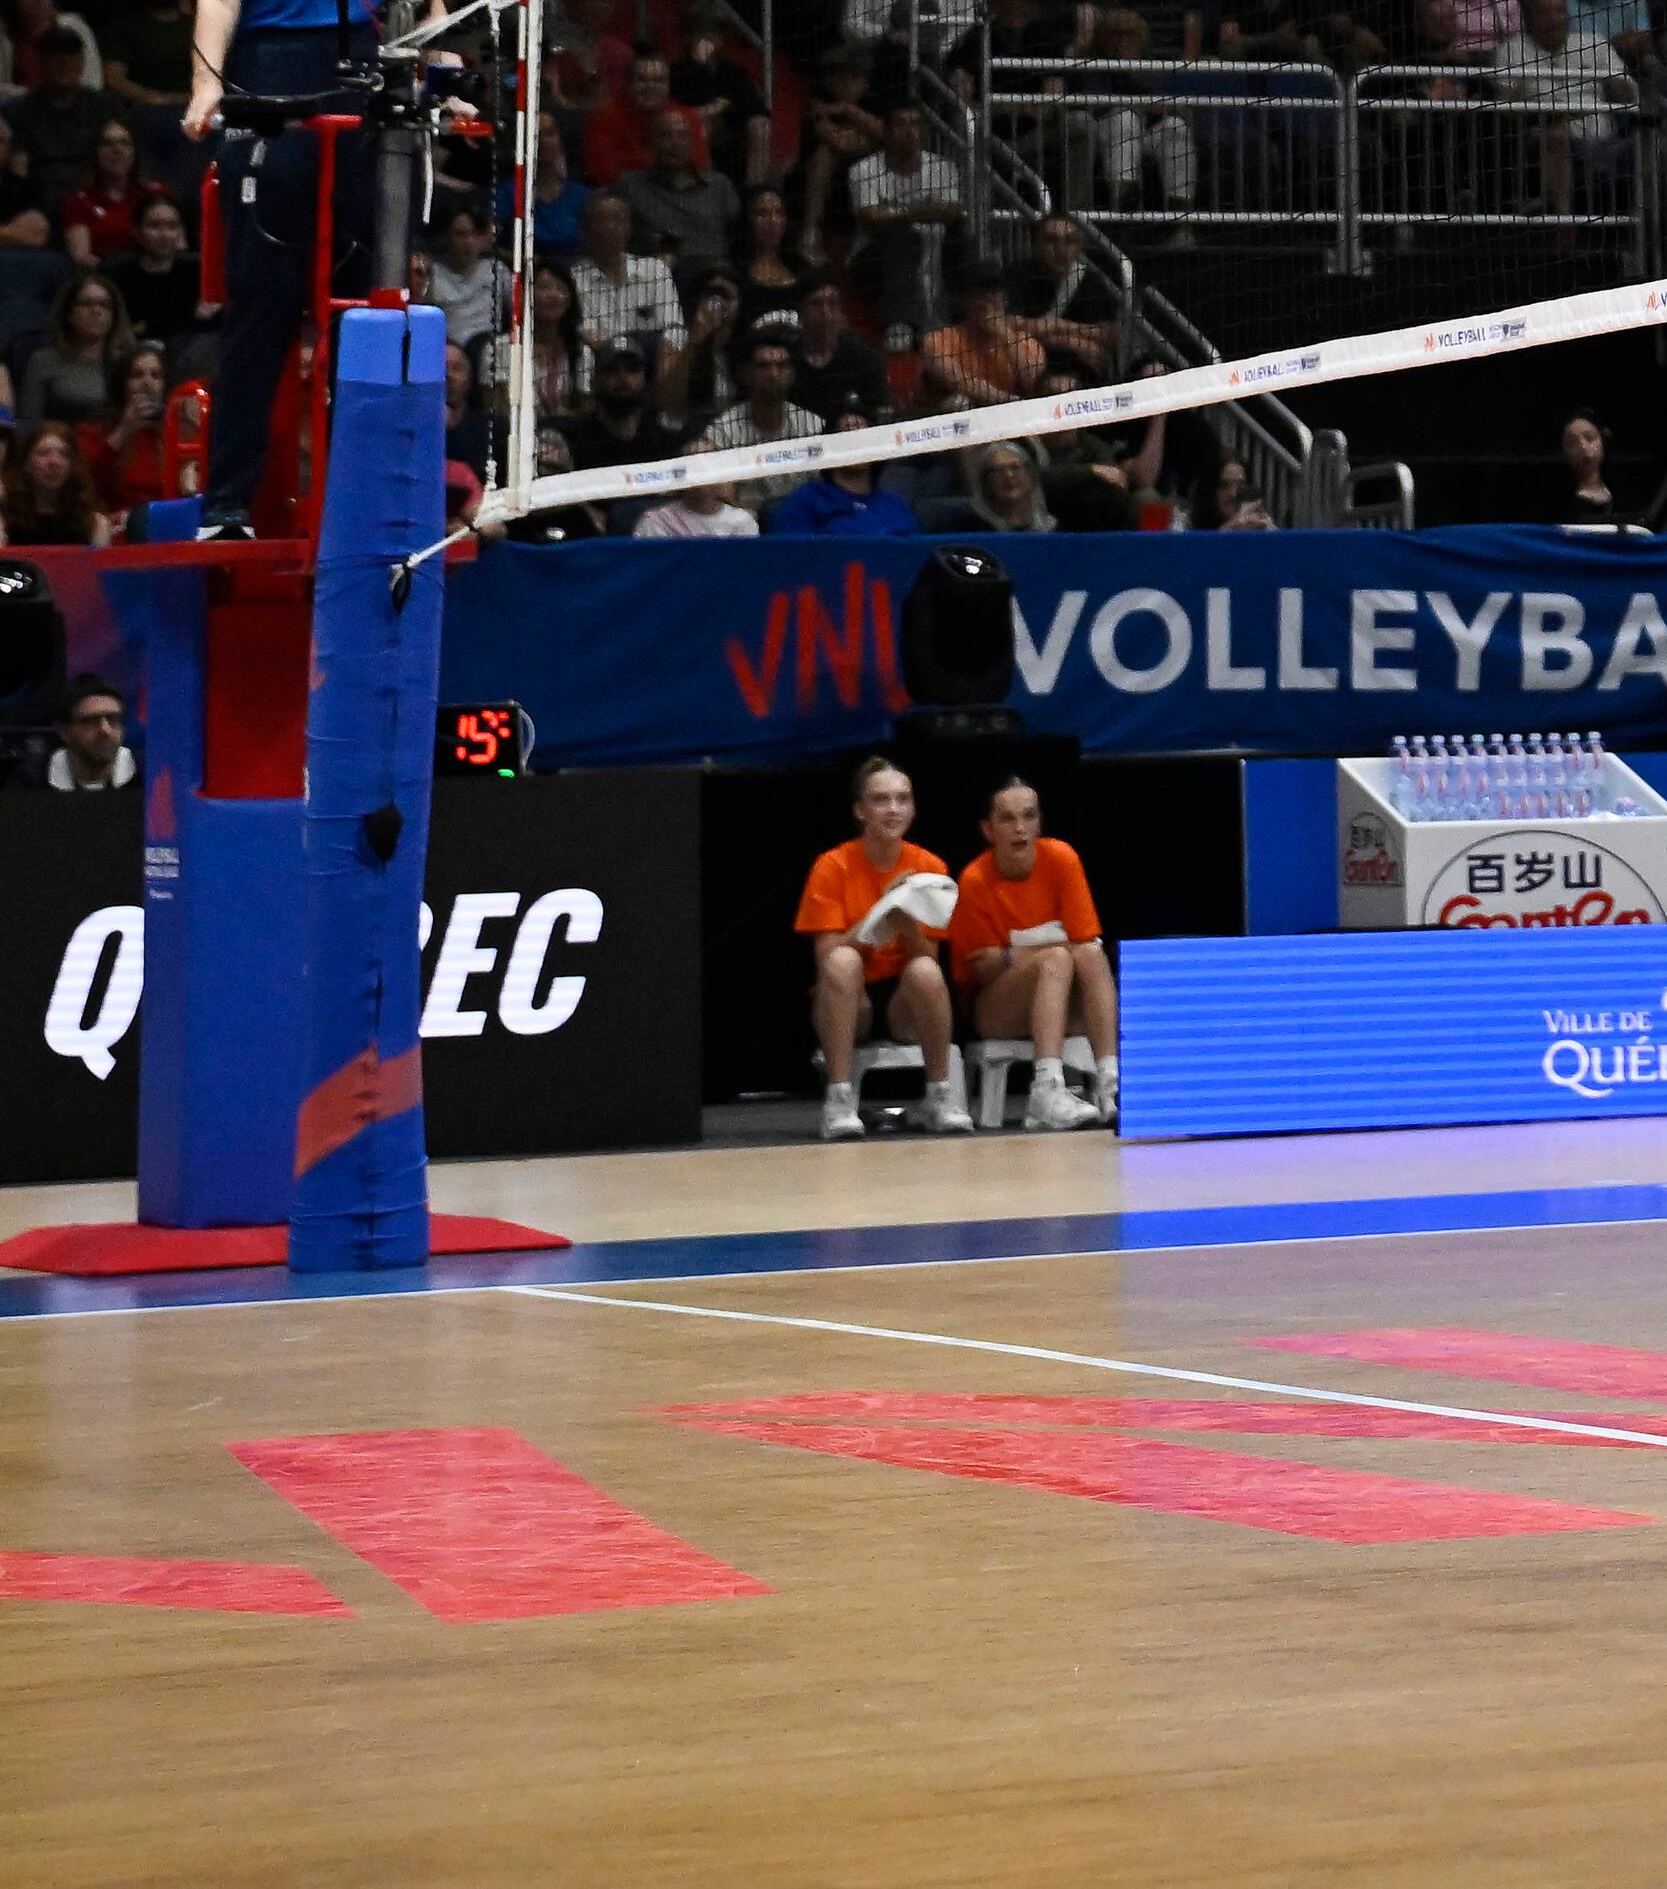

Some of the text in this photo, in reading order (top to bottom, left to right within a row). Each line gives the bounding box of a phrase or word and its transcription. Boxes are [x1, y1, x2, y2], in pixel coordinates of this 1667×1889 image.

[1438, 327, 1486, 348] VOLLEYBALL
[1466, 850, 1603, 895] 百岁山
[1541, 1009, 1654, 1035] VILLE DE
